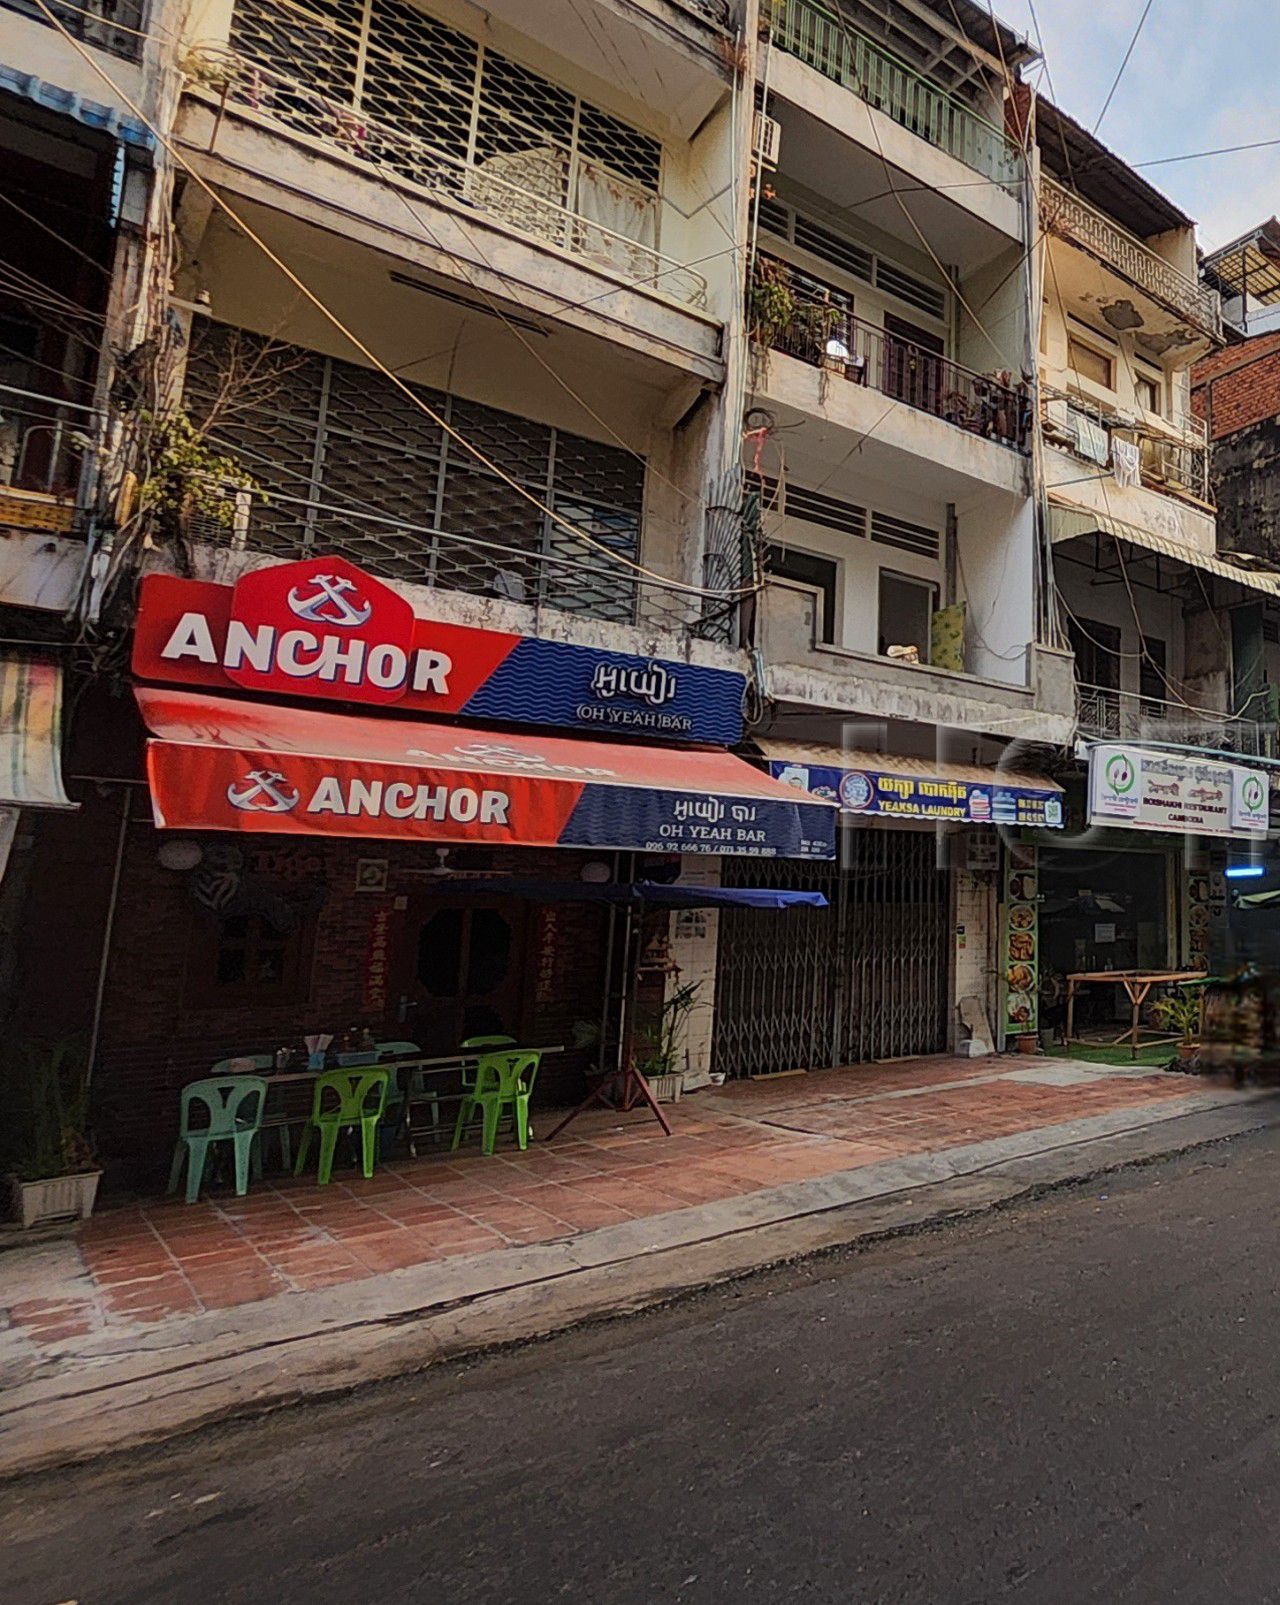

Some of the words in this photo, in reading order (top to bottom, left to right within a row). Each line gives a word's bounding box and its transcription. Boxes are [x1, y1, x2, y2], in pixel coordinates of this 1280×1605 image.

[160, 612, 453, 695] ANCHOR
[579, 705, 605, 720] OH
[611, 709, 656, 727] YEAH
[661, 715, 693, 730] BAR
[306, 776, 510, 825] ANCHOR
[877, 800, 920, 814] YEAKSA
[921, 804, 967, 818] LAUNDRY
[659, 824, 684, 838] OH
[689, 825, 732, 841] YEAH
[736, 829, 767, 843] BAR
